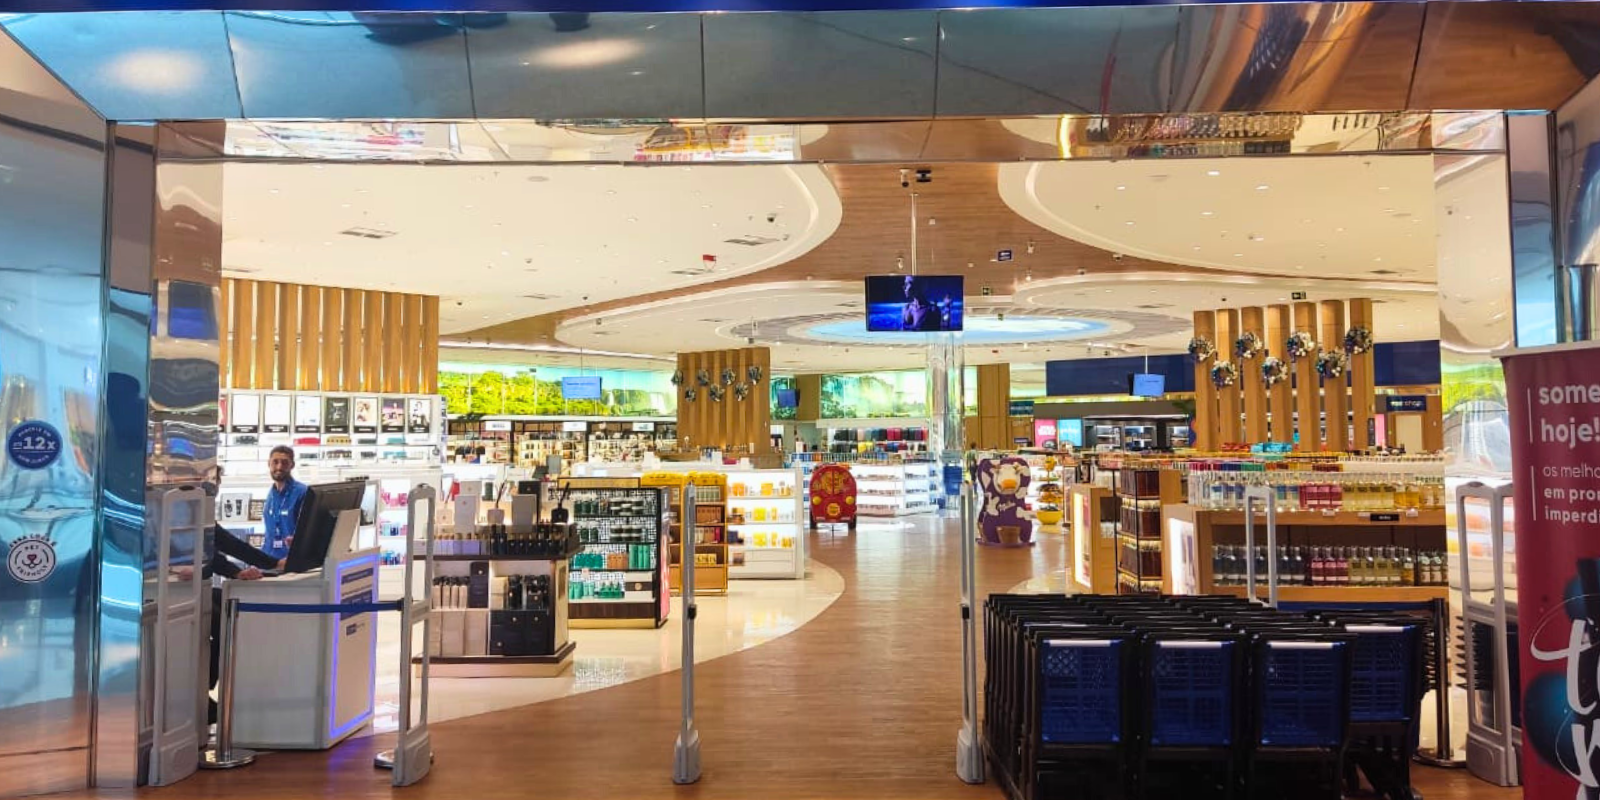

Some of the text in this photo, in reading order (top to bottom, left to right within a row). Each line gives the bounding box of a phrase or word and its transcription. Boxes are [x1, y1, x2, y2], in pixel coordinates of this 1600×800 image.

[1538, 384, 1600, 405] some
[1541, 417, 1600, 449] hoje!
[23, 437, 56, 450] 12x
[1543, 466, 1558, 477] os
[1544, 487, 1565, 499] em
